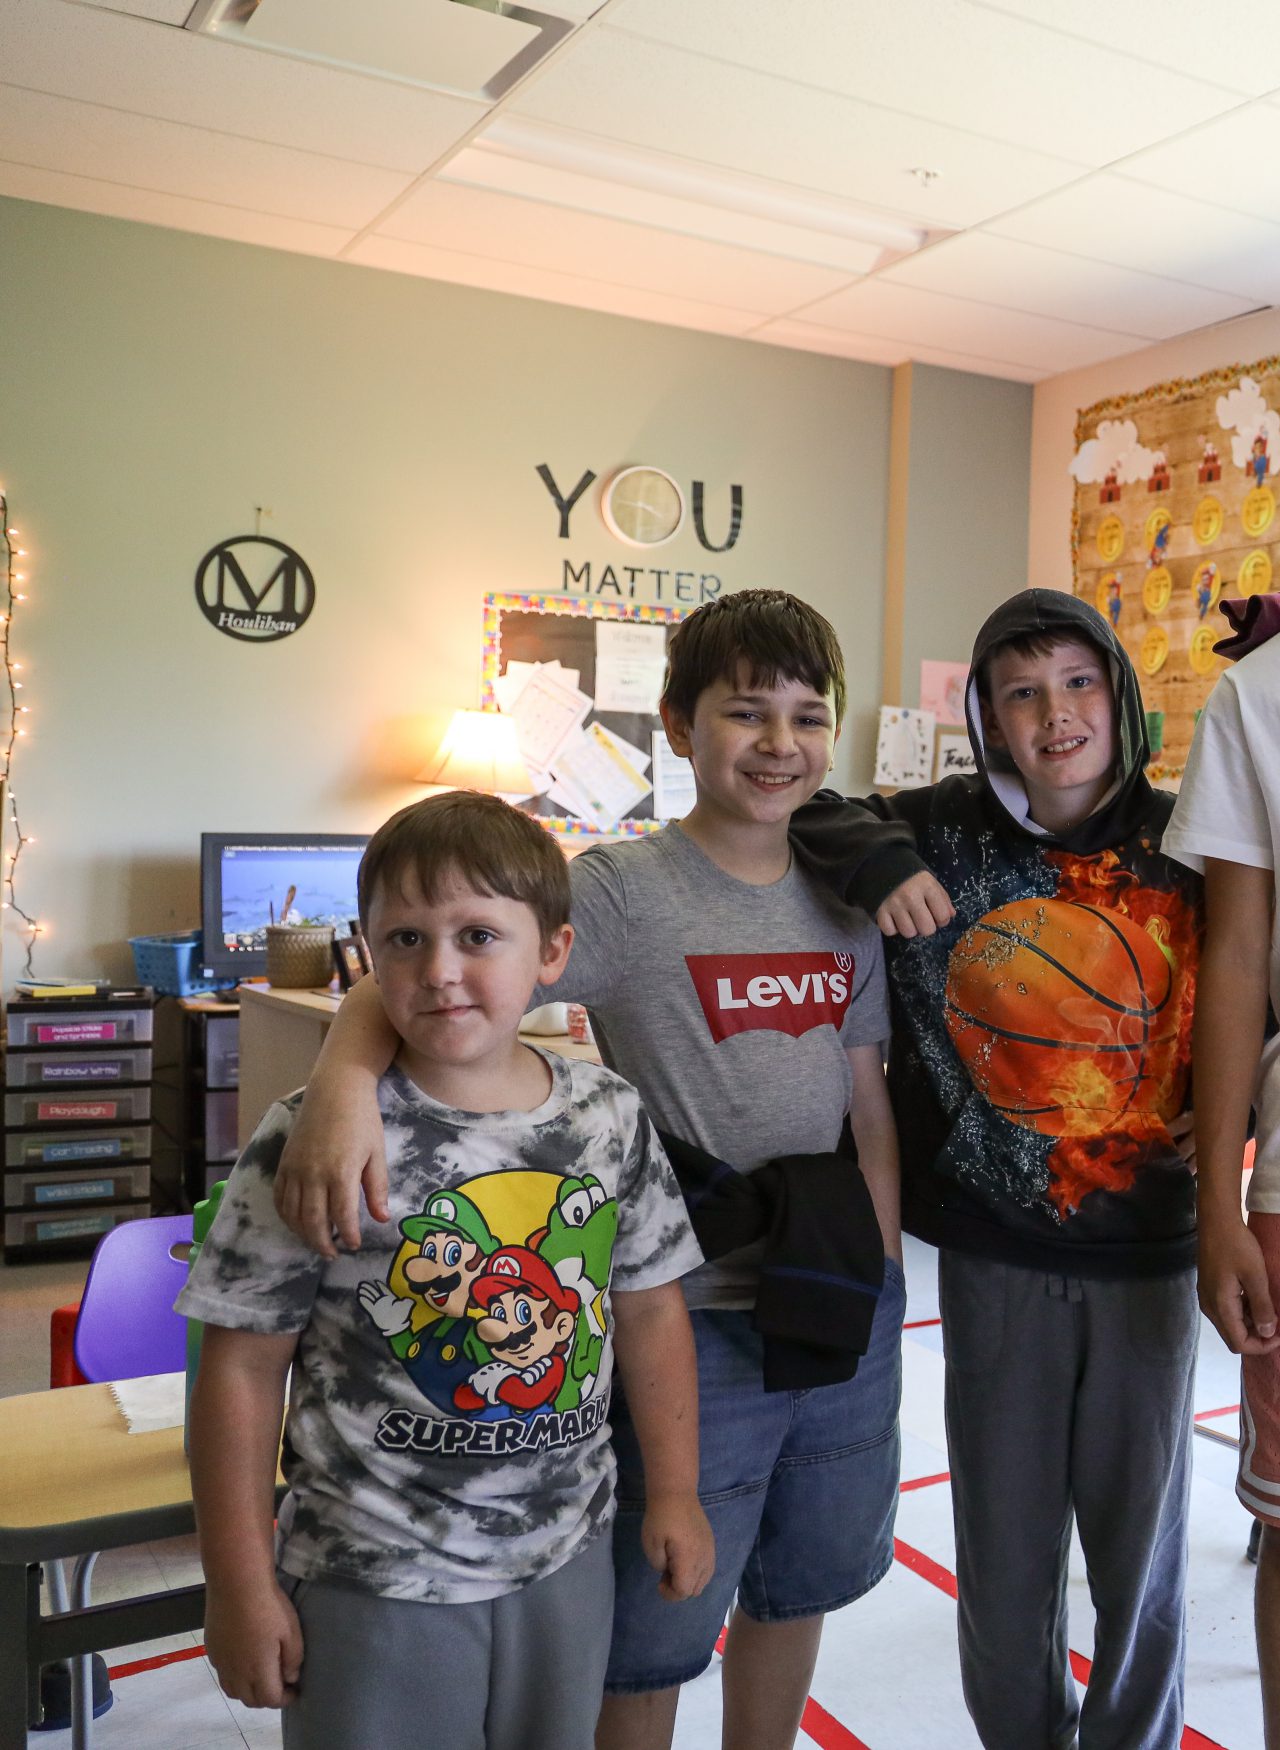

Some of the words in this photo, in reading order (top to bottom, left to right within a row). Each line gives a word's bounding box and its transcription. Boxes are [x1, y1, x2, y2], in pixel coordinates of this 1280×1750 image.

[206, 550, 303, 615] M
[562, 559, 722, 602] MATTER
[217, 612, 297, 633] Houlihan
[44, 1066, 87, 1076] Rainbow
[49, 1106, 107, 1116] Playdough
[374, 1407, 526, 1457] SUPER
